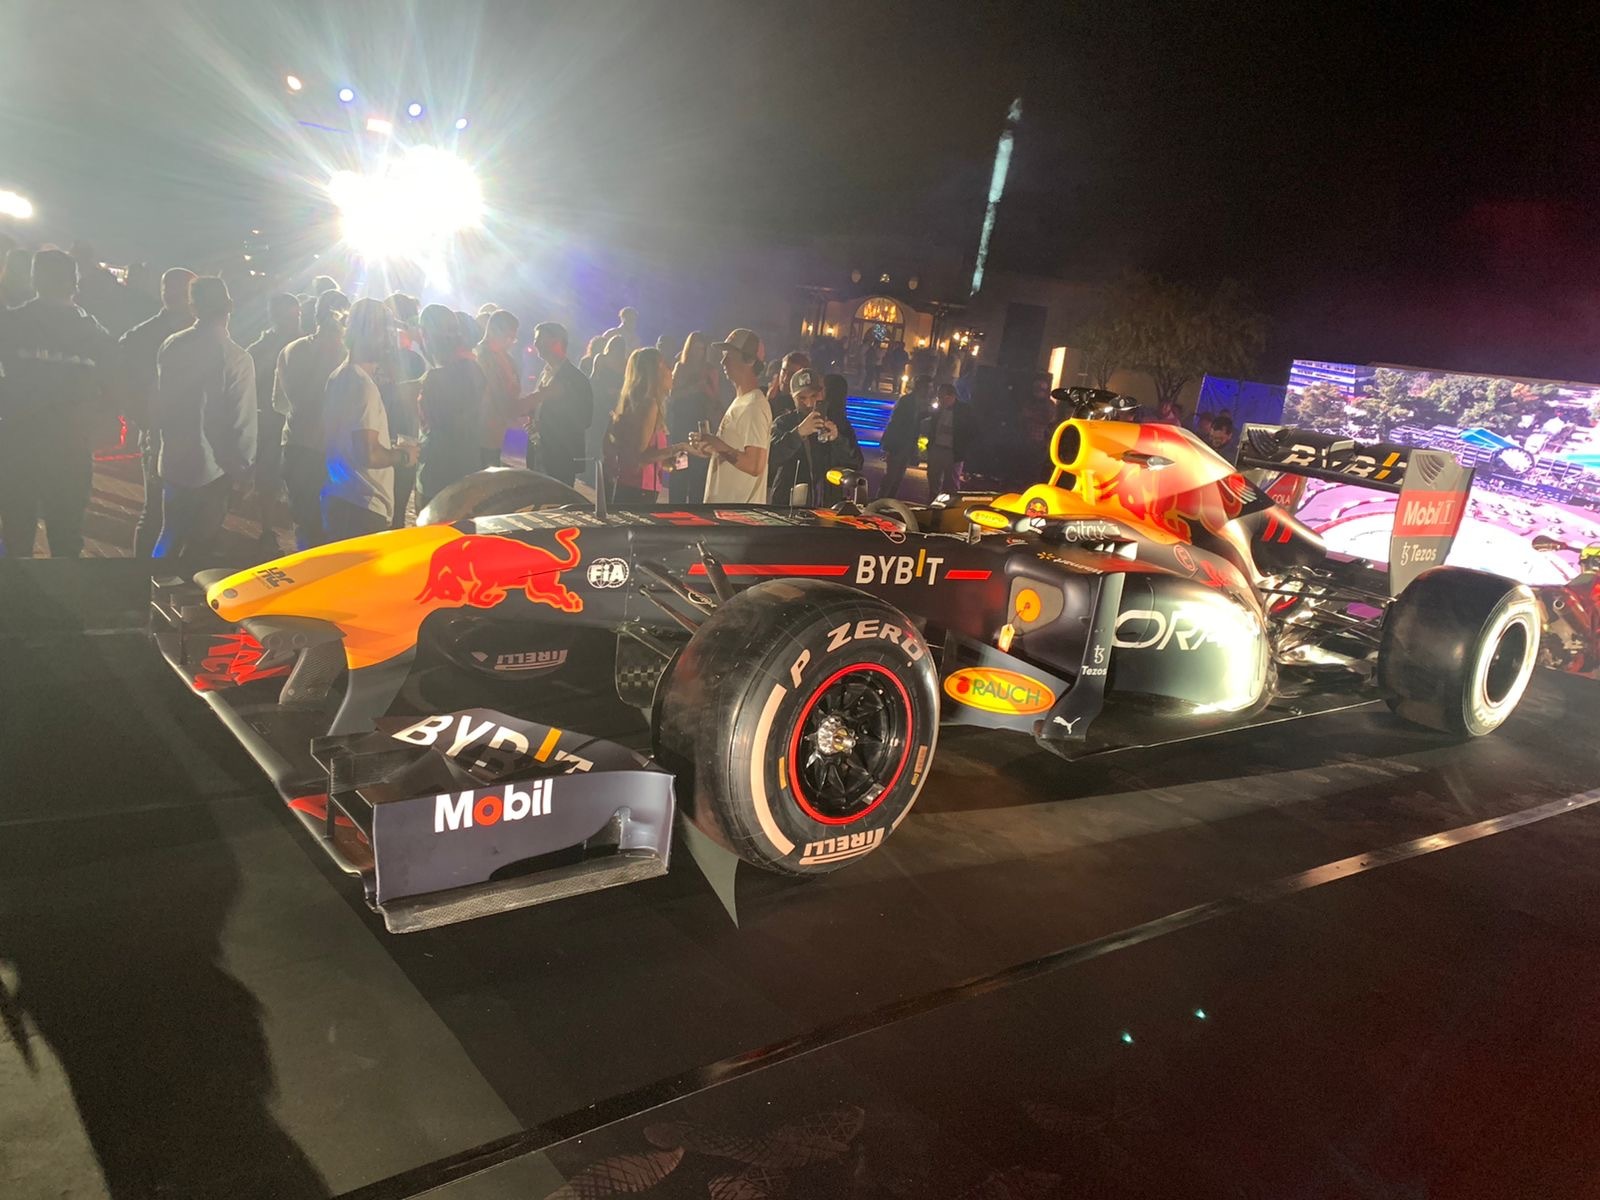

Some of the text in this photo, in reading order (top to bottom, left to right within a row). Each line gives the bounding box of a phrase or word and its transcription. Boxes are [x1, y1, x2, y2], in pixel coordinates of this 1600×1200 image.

[1403, 501, 1443, 526] Mobil
[1065, 520, 1107, 542] citrix
[1411, 544, 1437, 562] Tezos
[856, 549, 944, 585] BYBIT
[494, 650, 568, 671] PIRELLI
[790, 619, 924, 688] P ZERO
[1081, 665, 1107, 676] Tezos
[972, 679, 1041, 706] RAUCH
[434, 778, 554, 833] Mobil
[799, 827, 885, 865] PIRELLI
